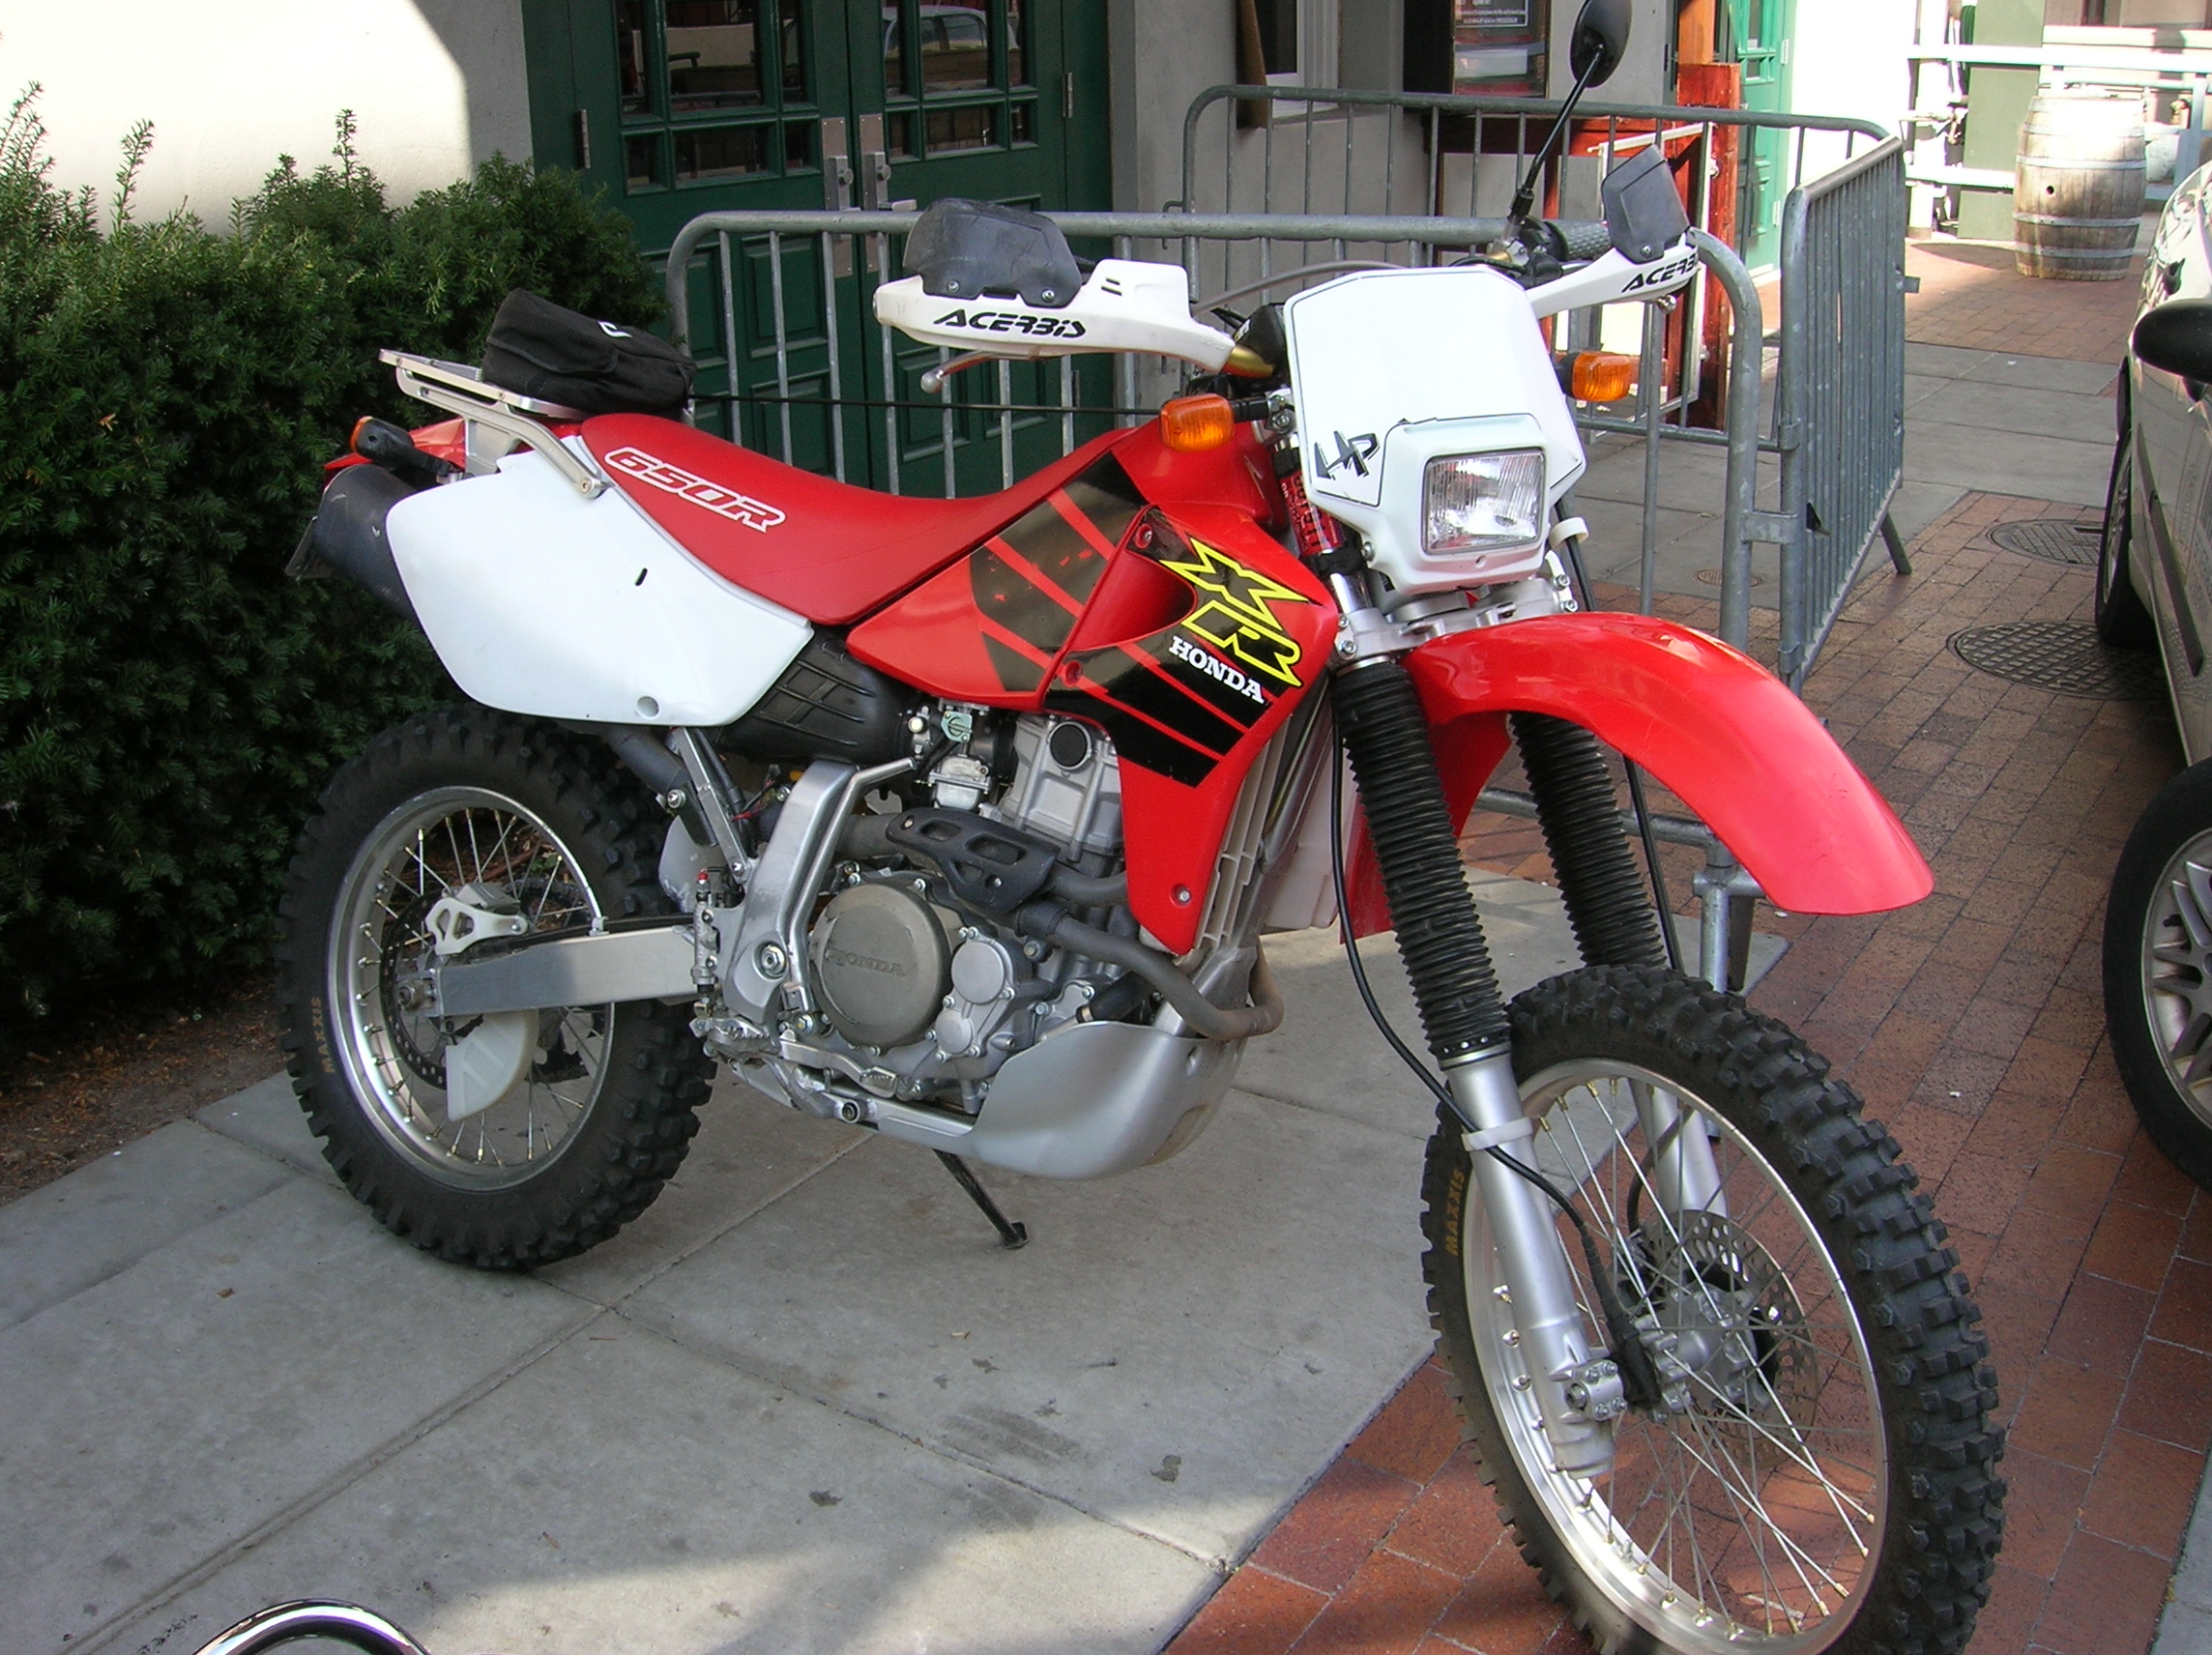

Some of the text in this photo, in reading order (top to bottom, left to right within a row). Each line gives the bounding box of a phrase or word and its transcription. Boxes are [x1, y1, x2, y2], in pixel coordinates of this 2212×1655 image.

[1620, 251, 1698, 293] ACERB
[933, 308, 1088, 338] ACERBIS
[1168, 635, 1266, 705] HONDA
[828, 946, 907, 978] HONDA
[310, 996, 336, 1074] MAXXIS
[1444, 1169, 1466, 1257] MAXXIS
